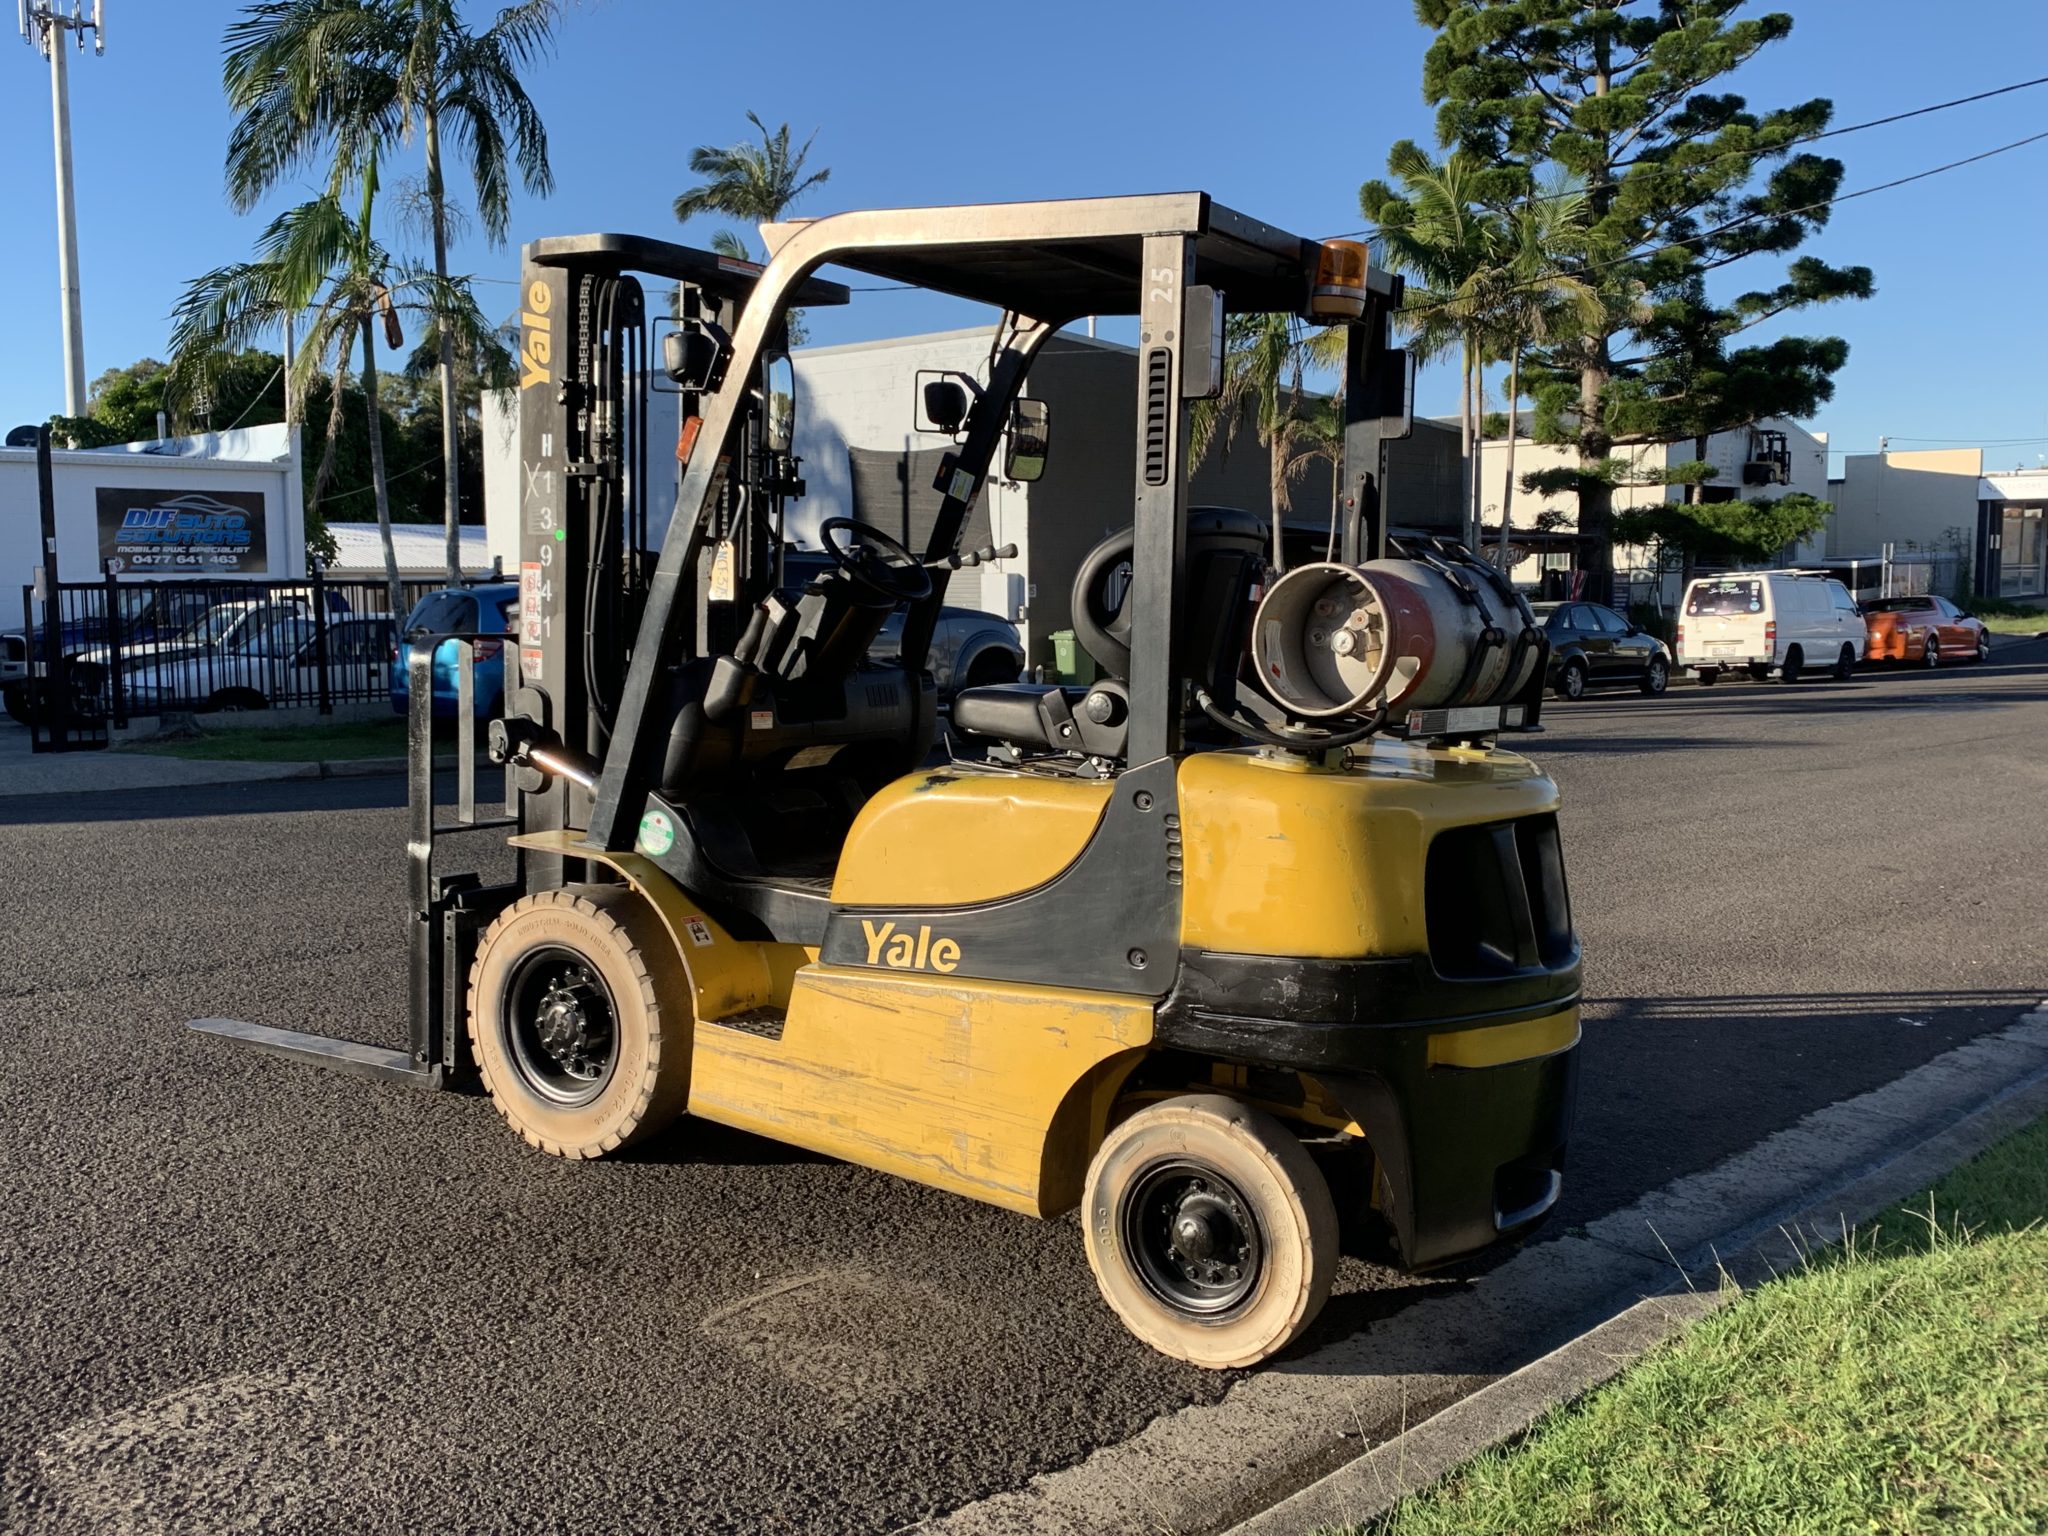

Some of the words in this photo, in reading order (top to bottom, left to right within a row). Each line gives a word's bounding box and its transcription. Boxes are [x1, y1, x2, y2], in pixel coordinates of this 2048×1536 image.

[1150, 267, 1174, 304] 25
[521, 280, 552, 391] Yale
[122, 508, 179, 529] DJF
[132, 555, 172, 564] 0477
[176, 555, 204, 564] 641
[209, 555, 238, 564] 463
[861, 919, 961, 973] Yale
